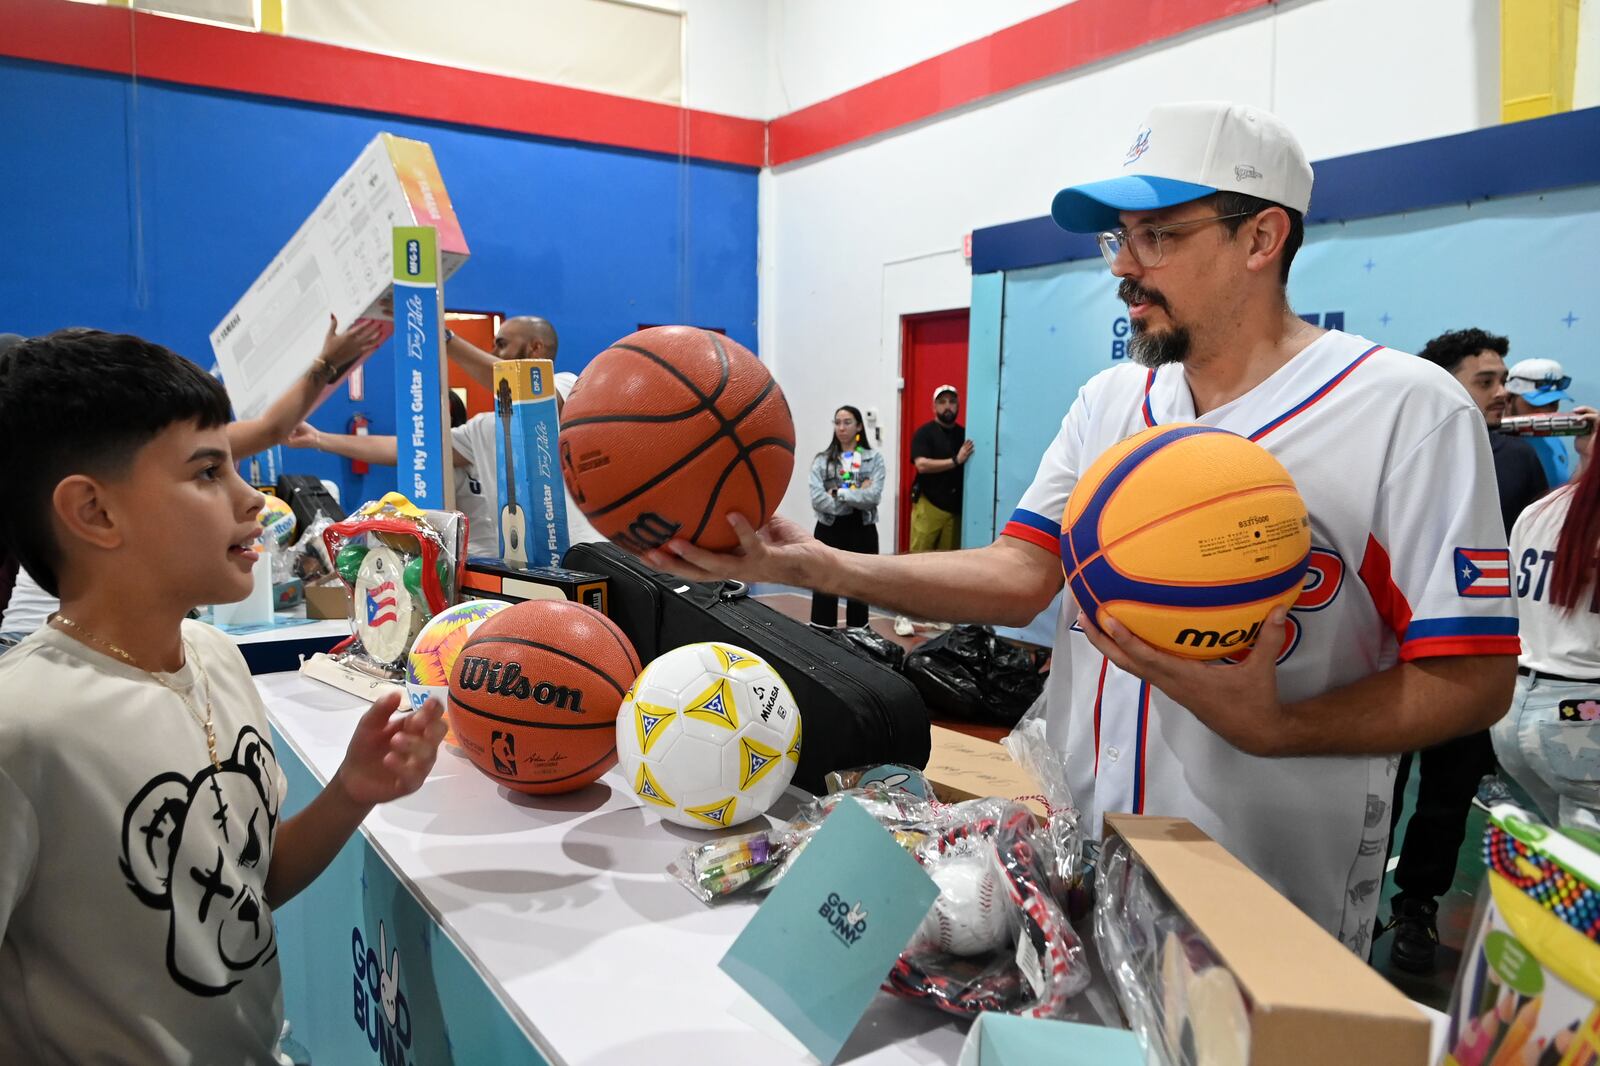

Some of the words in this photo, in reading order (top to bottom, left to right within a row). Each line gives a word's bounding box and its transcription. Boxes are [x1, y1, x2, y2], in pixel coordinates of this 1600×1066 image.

[409, 241, 418, 274] MFG-36
[410, 369, 424, 413] Guitar
[533, 369, 541, 392] DP-21
[412, 414, 425, 447] First
[413, 449, 428, 471] My
[543, 484, 555, 520] Guitar
[548, 521, 558, 549] First
[549, 552, 561, 573] My
[459, 656, 585, 714] Wilson
[818, 901, 862, 945] BUNNY
